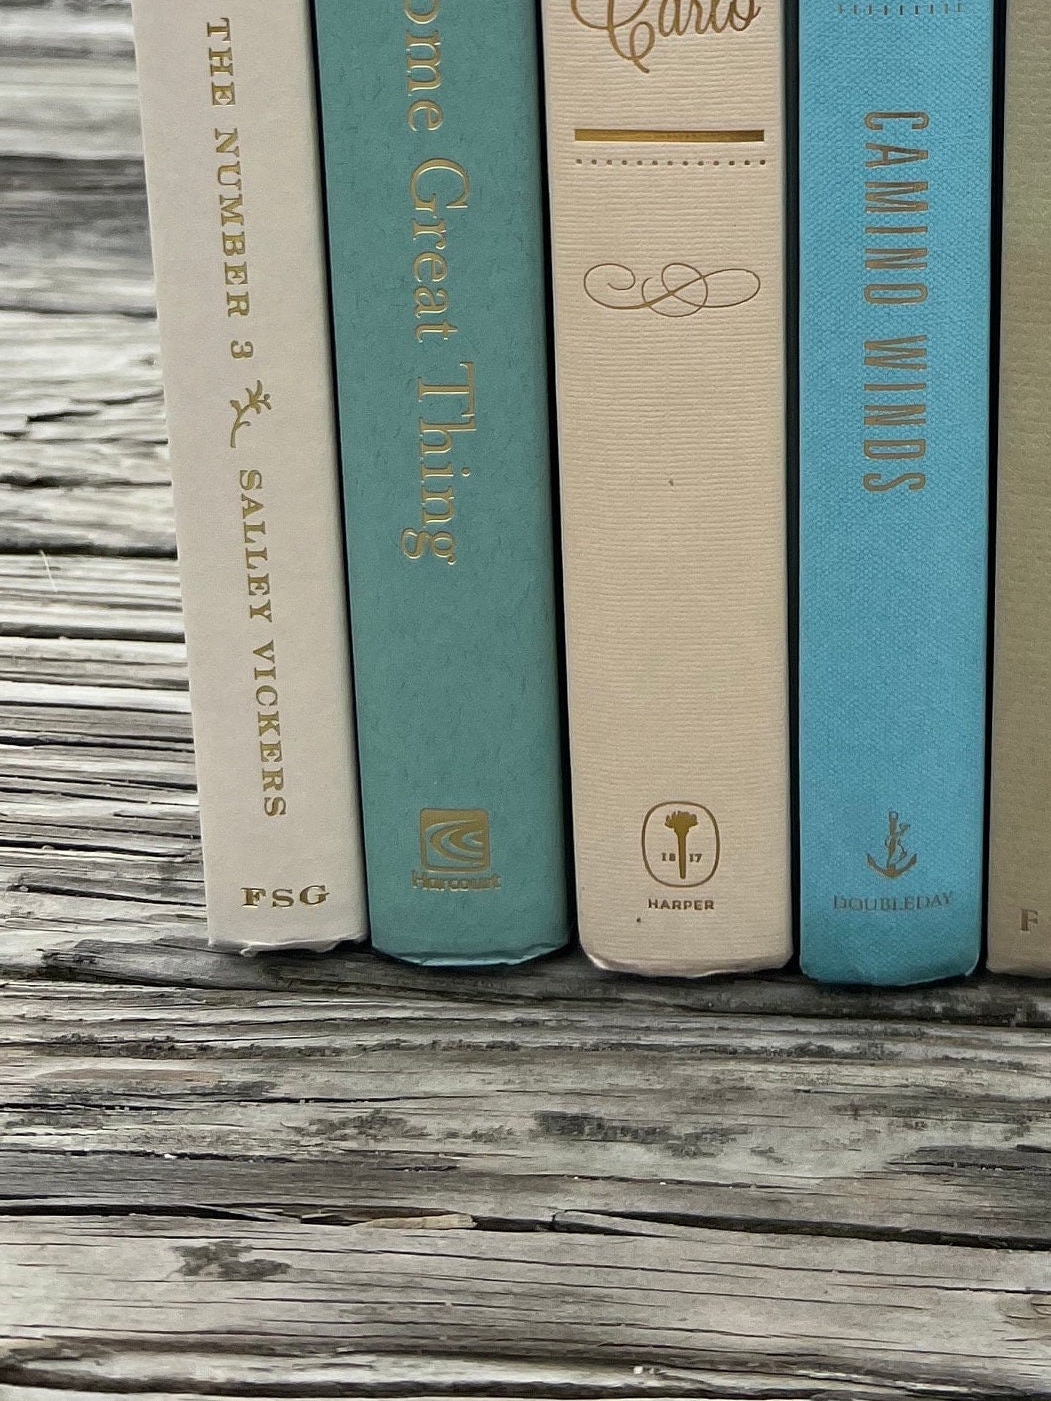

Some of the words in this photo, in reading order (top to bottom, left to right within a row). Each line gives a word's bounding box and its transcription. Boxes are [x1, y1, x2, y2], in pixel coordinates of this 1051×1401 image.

[206, 17, 236, 107] THE
[215, 127, 250, 318] NUMBER
[408, 157, 471, 343] Great
[864, 111, 929, 305] CAMINO
[230, 341, 254, 360] 3
[863, 334, 928, 493] WINDS
[400, 360, 477, 565] Thing
[239, 468, 275, 624] SALLEY
[251, 639, 287, 818] VICKERS
[240, 884, 330, 909] FSG
[648, 899, 714, 910] HARPER
[833, 891, 953, 911] DOUBLEDAY
